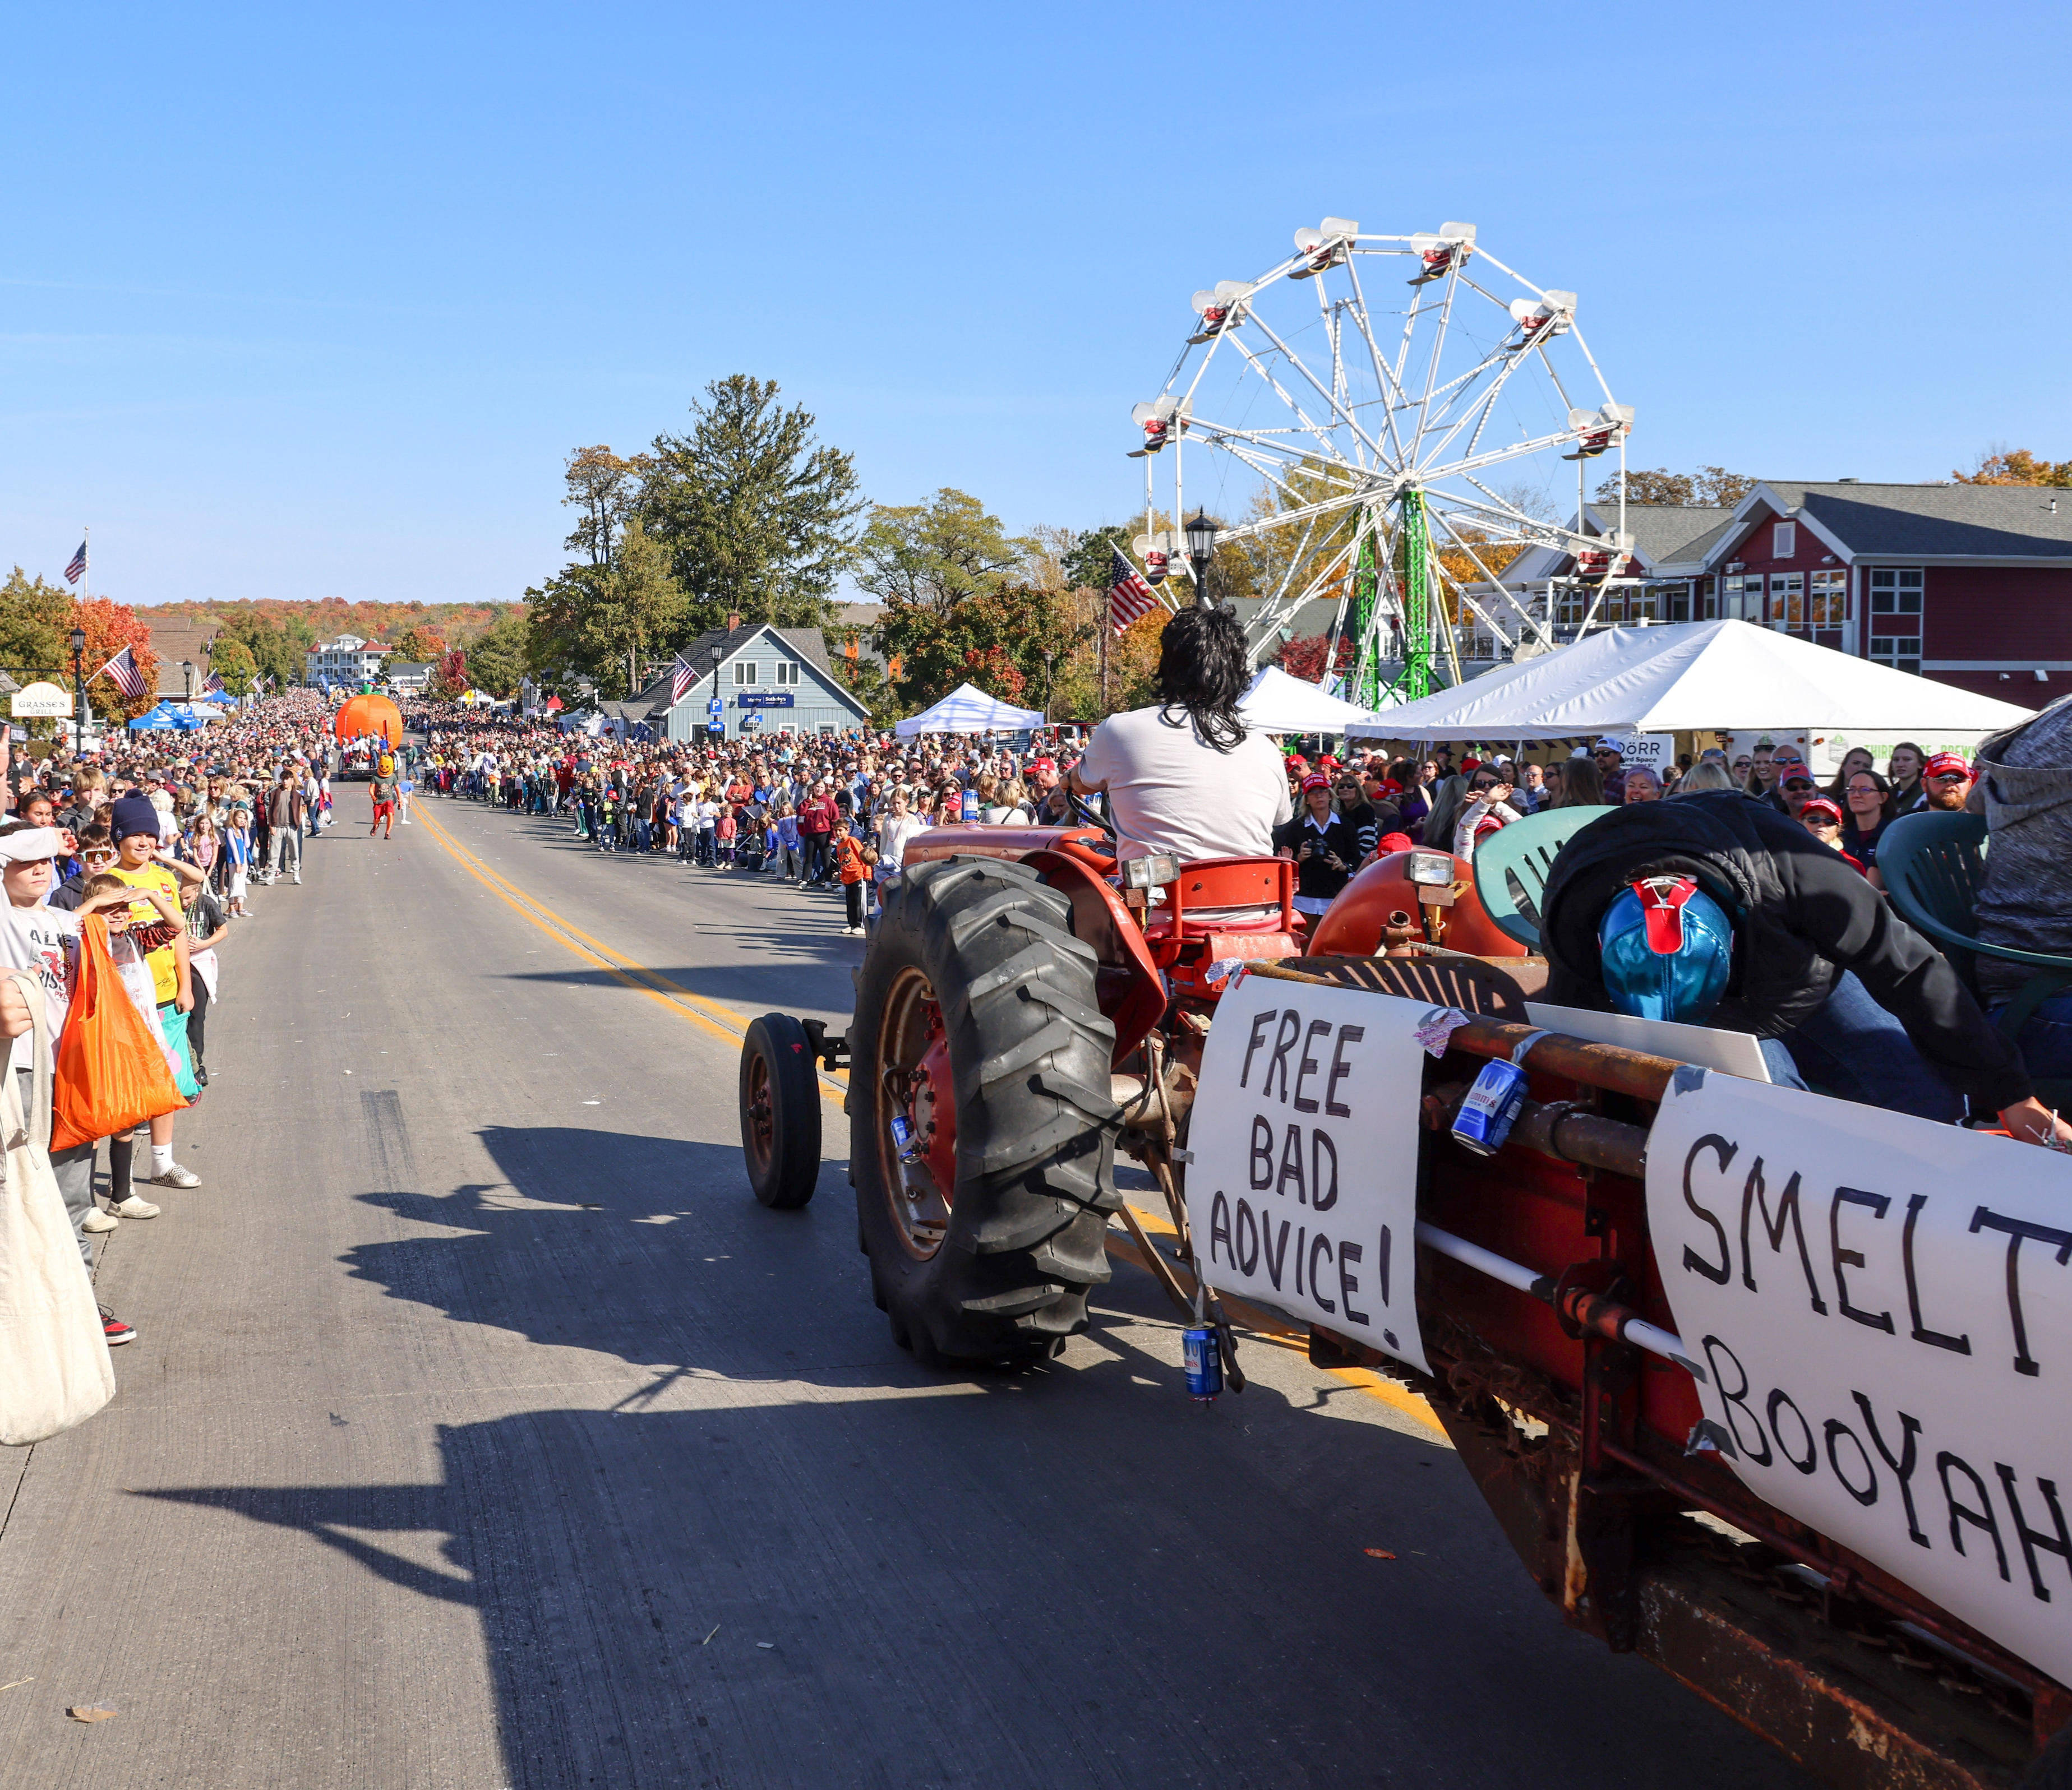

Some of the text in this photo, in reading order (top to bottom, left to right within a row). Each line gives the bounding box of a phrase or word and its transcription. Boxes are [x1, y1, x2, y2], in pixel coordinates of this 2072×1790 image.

[713, 700, 720, 710] P
[1239, 1009, 1365, 1118] FREE
[1249, 1114, 1338, 1211] BAD
[1211, 1191, 1400, 1350] ADVICE!
[1683, 1133, 2072, 1377] SMELT
[1702, 1334, 2072, 1603] BOOYAH
